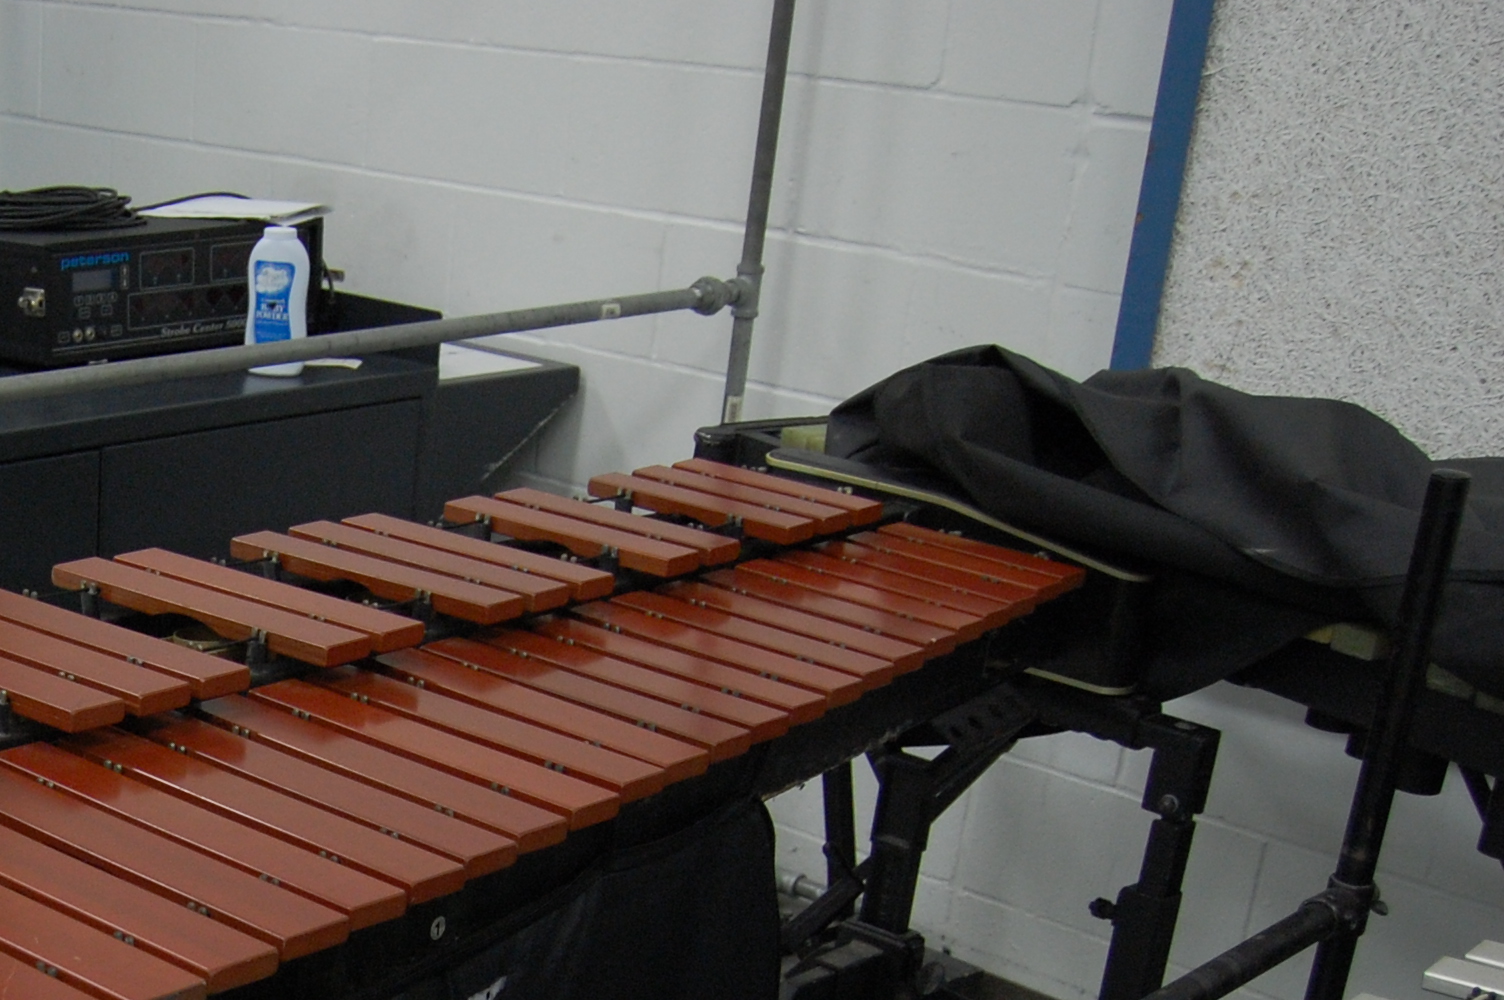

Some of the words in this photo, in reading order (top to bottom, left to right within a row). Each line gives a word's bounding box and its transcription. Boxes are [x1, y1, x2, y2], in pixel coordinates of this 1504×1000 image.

[60, 252, 130, 271] peterson
[261, 302, 284, 312] BDY
[160, 324, 191, 338] Strobe
[193, 321, 225, 333] Center
